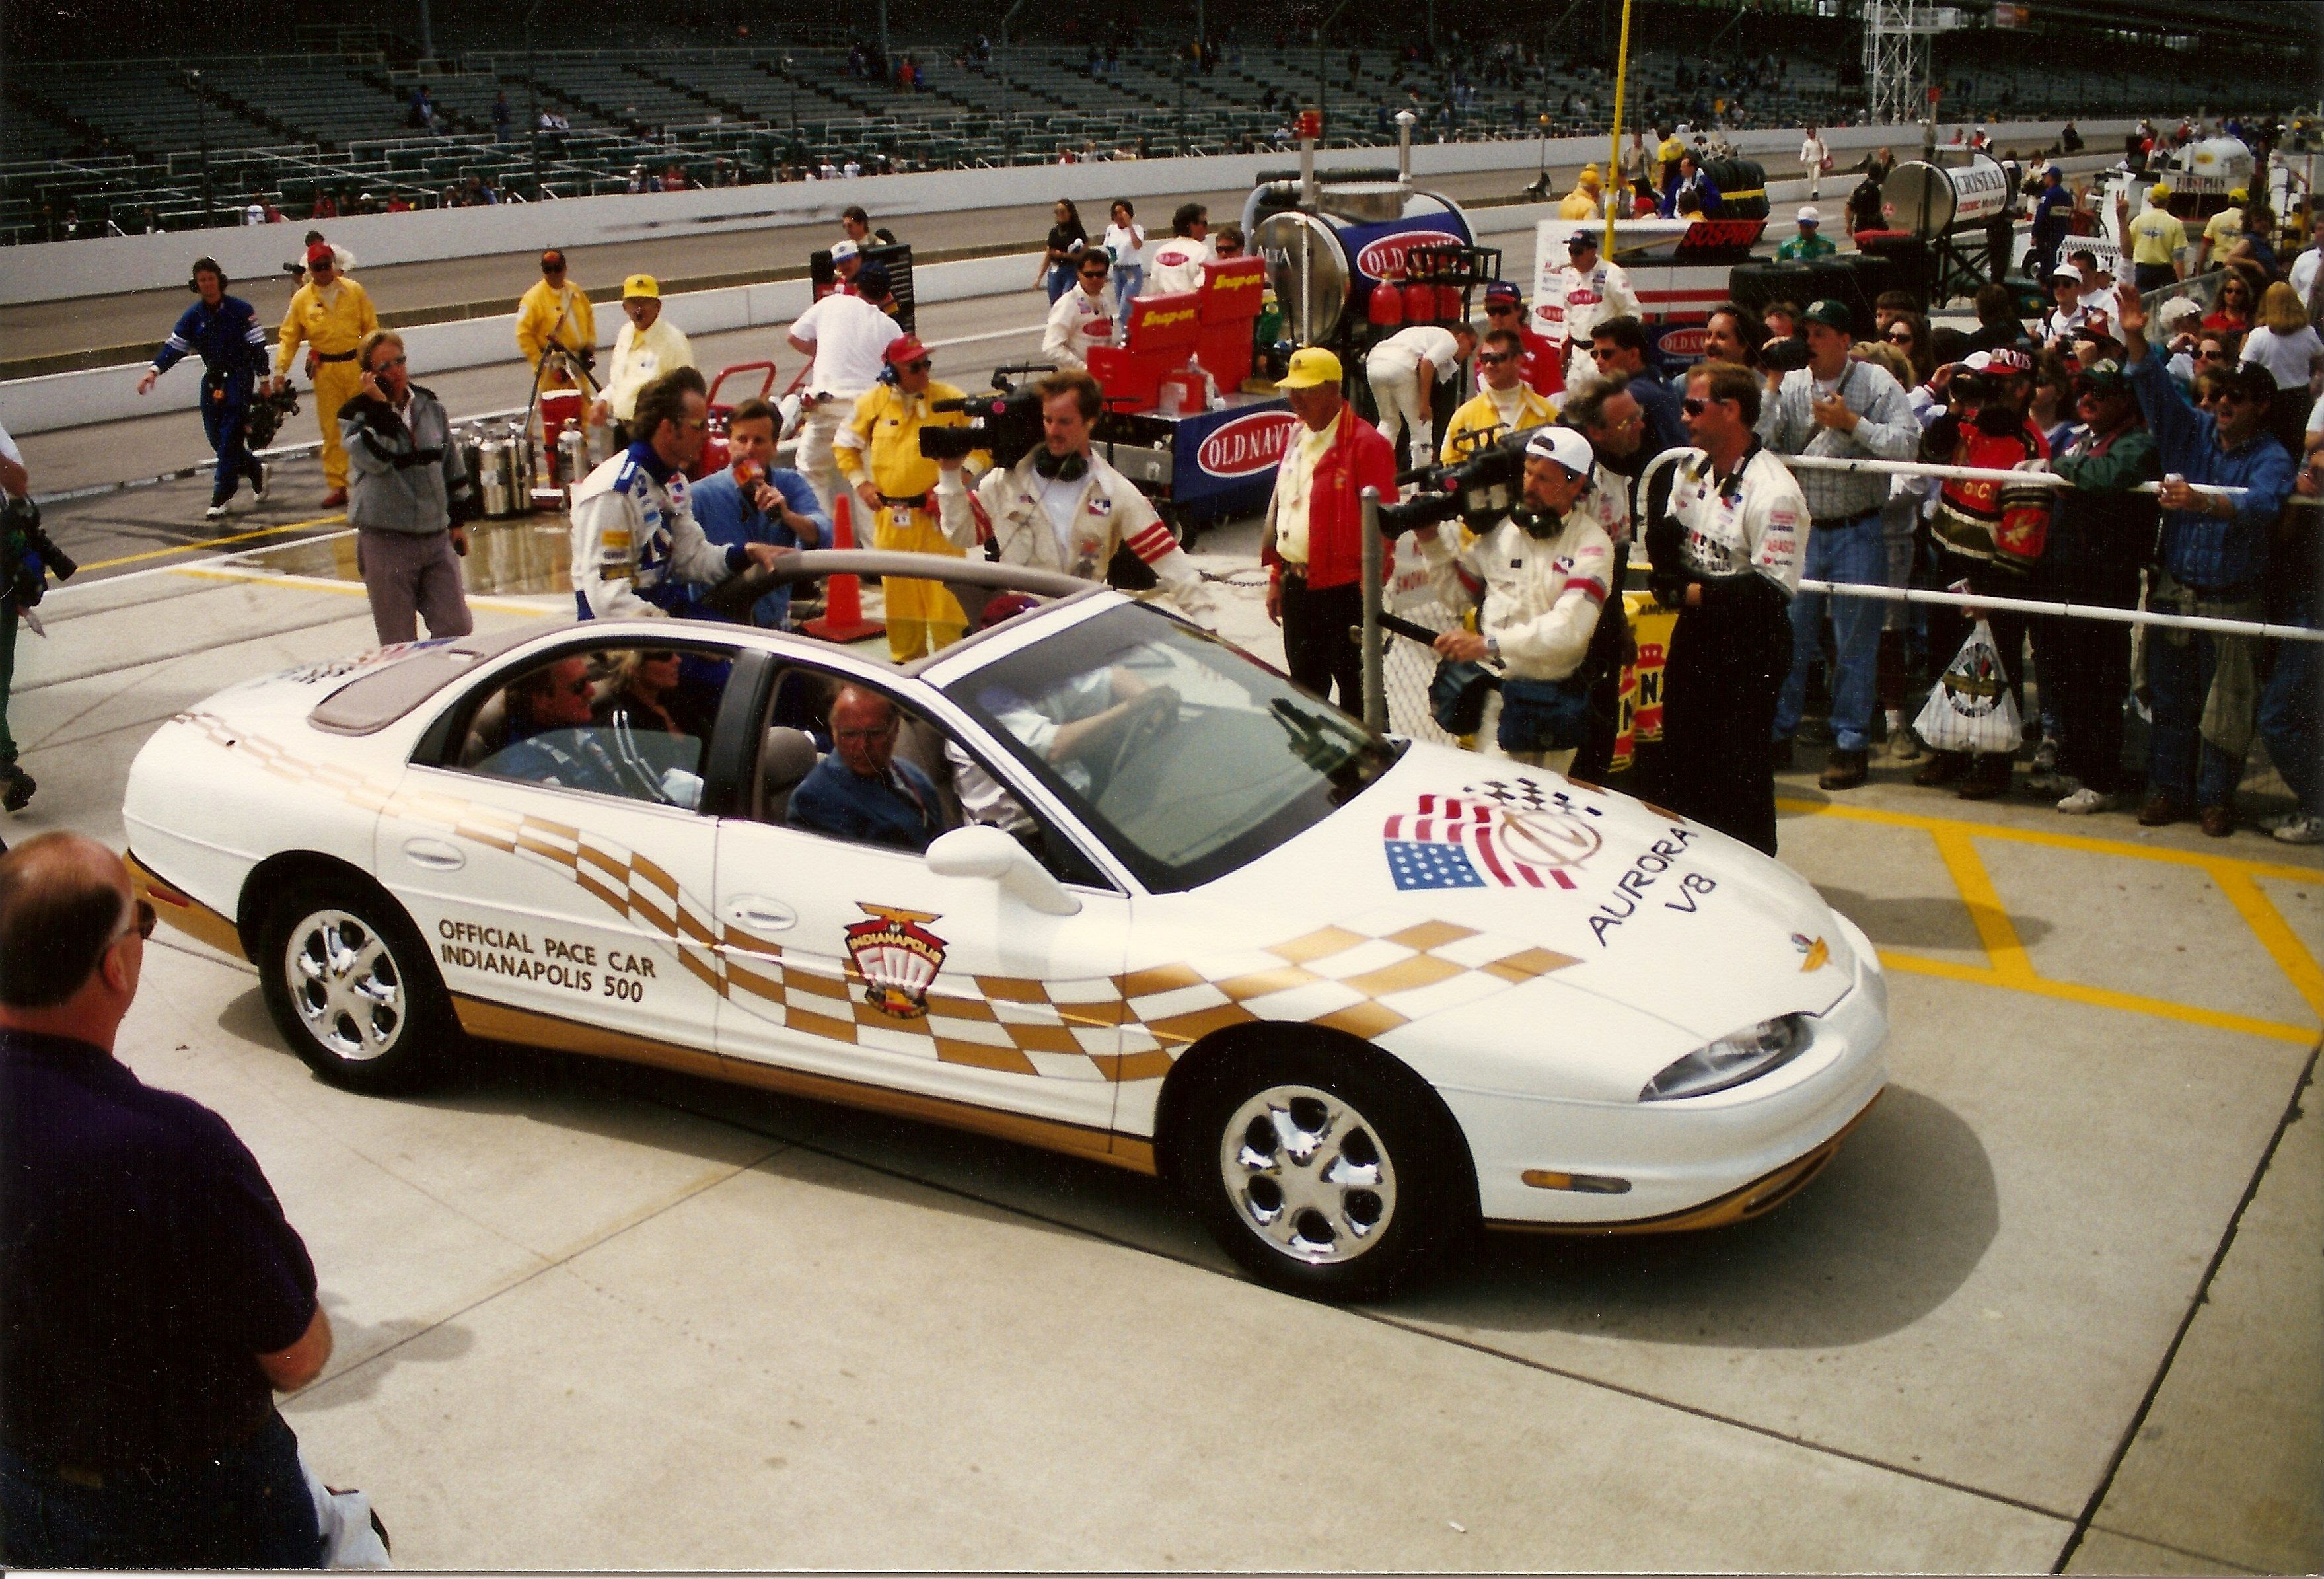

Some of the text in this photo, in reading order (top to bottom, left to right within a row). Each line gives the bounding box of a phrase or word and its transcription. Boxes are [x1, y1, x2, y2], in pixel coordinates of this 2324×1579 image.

[1955, 170, 2004, 196] CRISTAL
[1367, 247, 1404, 274] OLD
[1665, 336, 1688, 351] OLD
[1208, 434, 1246, 468] OLD
[1589, 828, 1698, 947] AURORA
[1665, 873, 1716, 912] V8
[439, 918, 656, 978] OFFICIAL PACE CAR
[848, 932, 943, 965] INDIANAPOLIS
[441, 943, 643, 1003] INDIANAPOLIS 500
[855, 946, 937, 991] 500
